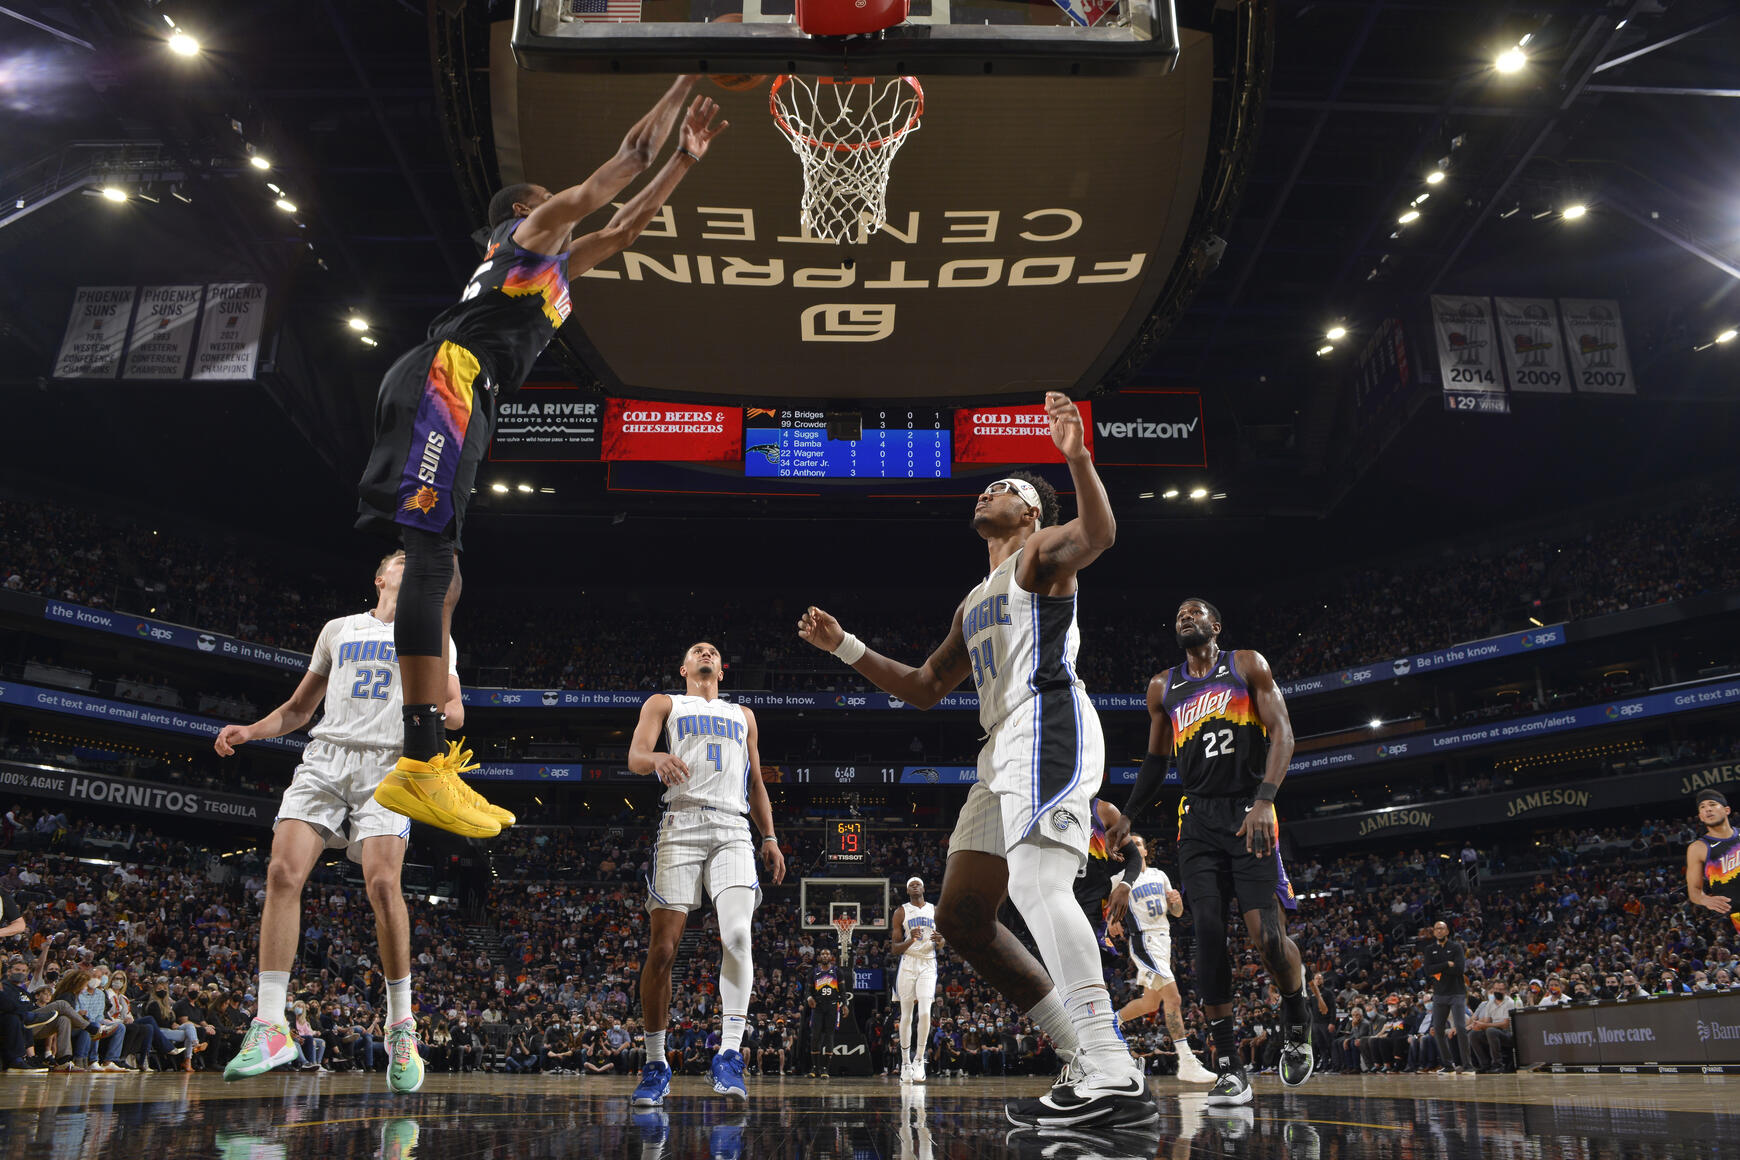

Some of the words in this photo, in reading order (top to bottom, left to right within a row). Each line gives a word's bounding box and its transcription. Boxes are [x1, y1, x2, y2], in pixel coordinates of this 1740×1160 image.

[78, 290, 132, 303] PHOENIX
[144, 290, 198, 302] PHOENIX
[212, 287, 263, 299] PHOENIX
[84, 304, 117, 316] SUNS
[151, 304, 184, 316] SUNS
[218, 301, 250, 314] SUNS
[1451, 368, 1496, 384] 2014
[1516, 370, 1562, 386] 2009
[1582, 370, 1626, 387] 2007
[499, 403, 540, 415] GILA
[544, 403, 596, 415] RIVER
[1458, 396, 1476, 409] 29
[622, 411, 661, 423] COLD
[664, 411, 713, 423] BEERS
[716, 411, 725, 423] &
[794, 410, 824, 420] Bridges
[972, 414, 1011, 425] COLD
[622, 424, 724, 434] CHEESEBURGERS
[781, 420, 792, 428] 99
[794, 420, 826, 428] Crowder
[1096, 418, 1188, 439] verizon
[783, 430, 788, 438] 4
[794, 430, 819, 439] Suggs
[783, 440, 788, 448] 5
[794, 440, 822, 448] Bamba
[850, 440, 856, 448] 0
[418, 431, 445, 485] SUNS
[794, 450, 824, 458] Wagner
[880, 450, 886, 458] 0
[908, 450, 913, 458] 0
[936, 450, 940, 458] 0
[936, 460, 940, 468] 0
[793, 469, 826, 478] Anthony
[52, 605, 73, 618] the
[76, 610, 112, 627] know.
[150, 627, 173, 640] aps
[1535, 632, 1556, 644] aps
[223, 641, 238, 654] Be
[240, 645, 251, 656] in
[254, 649, 272, 660] the
[274, 652, 304, 668] know.
[1416, 658, 1432, 668] Be
[1434, 655, 1444, 664] in
[1446, 651, 1464, 662] the
[1467, 644, 1500, 658] know.
[970, 636, 998, 689] 34
[1353, 670, 1372, 681] aps
[350, 668, 393, 700] 22
[1295, 681, 1323, 692] know.
[502, 694, 521, 704] aps
[565, 694, 579, 702] Be
[581, 694, 592, 702] in
[594, 694, 610, 703] the
[612, 694, 642, 704] know.
[738, 696, 752, 704] Be
[754, 695, 764, 704] in
[766, 696, 783, 704] the
[786, 696, 816, 704] know.
[847, 696, 866, 706] aps
[940, 696, 956, 705] the
[1098, 696, 1109, 706] in
[1111, 697, 1128, 706] the
[1674, 694, 1696, 705] Get
[1698, 690, 1722, 702] text
[37, 694, 58, 705] Get
[61, 698, 84, 710] text
[85, 702, 107, 714] and
[109, 706, 138, 719] email
[141, 711, 170, 724] alerts
[172, 714, 187, 728] for
[1174, 689, 1232, 733] Valley
[1620, 704, 1644, 716] aps
[677, 714, 744, 748] MAGIC
[1433, 736, 1460, 746] Learn
[1462, 732, 1487, 742] more
[1490, 728, 1501, 737] at
[1502, 714, 1576, 736] aps.com/alerts
[1202, 728, 1236, 759] 22
[1388, 744, 1408, 755] aps
[706, 742, 722, 772] 4
[1312, 757, 1328, 767] and
[1330, 754, 1356, 764] more.
[550, 768, 570, 778] aps
[796, 768, 810, 783] 11
[834, 767, 856, 778] 6:48
[881, 768, 895, 783] 11
[0, 772, 29, 786] 100%
[30, 776, 65, 791] AGAVE
[69, 777, 200, 814] HORNITOS
[204, 800, 258, 818] TEQUILA
[1506, 789, 1590, 818] JAMESON
[838, 823, 861, 833] 6:47
[1359, 810, 1432, 836] JAMESON
[841, 834, 858, 852] 19
[1146, 898, 1164, 918] 50
[908, 916, 934, 930] MAGIC
[822, 987, 832, 996] 99
[1542, 1030, 1562, 1046] Less
[1564, 1030, 1596, 1048] worry.
[1597, 1026, 1626, 1043] More
[1626, 1026, 1656, 1042] care.
